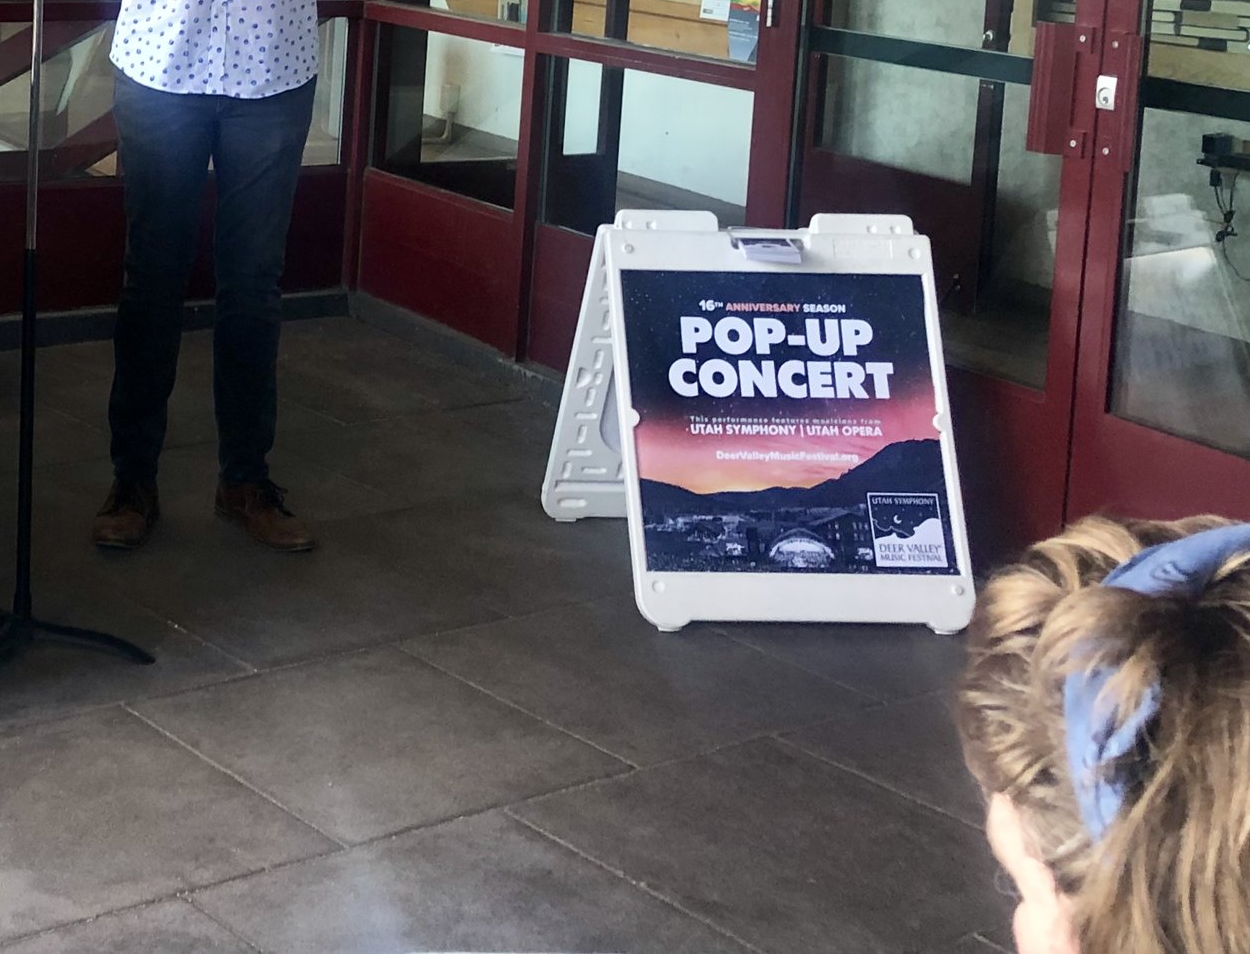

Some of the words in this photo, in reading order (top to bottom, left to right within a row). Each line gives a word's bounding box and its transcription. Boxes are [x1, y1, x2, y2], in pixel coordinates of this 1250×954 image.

[726, 302, 800, 313] ANNIVERSARY
[803, 303, 846, 313] SEASON
[680, 316, 874, 357] POP-UP
[668, 358, 894, 399] CONCERT
[712, 416, 768, 425] performance
[690, 424, 723, 435] UTAH
[726, 424, 797, 436] SYMPHONY
[806, 425, 839, 436] UTAH
[842, 426, 883, 437] OPERA
[716, 450, 859, 463] DeerValleyMusicFestival.org
[872, 497, 892, 505] UTAH
[894, 497, 935, 505] SYMPHONY
[879, 543, 904, 553] DEER
[880, 553, 906, 562] MUSIC
[908, 554, 943, 562] FESTIVAL
